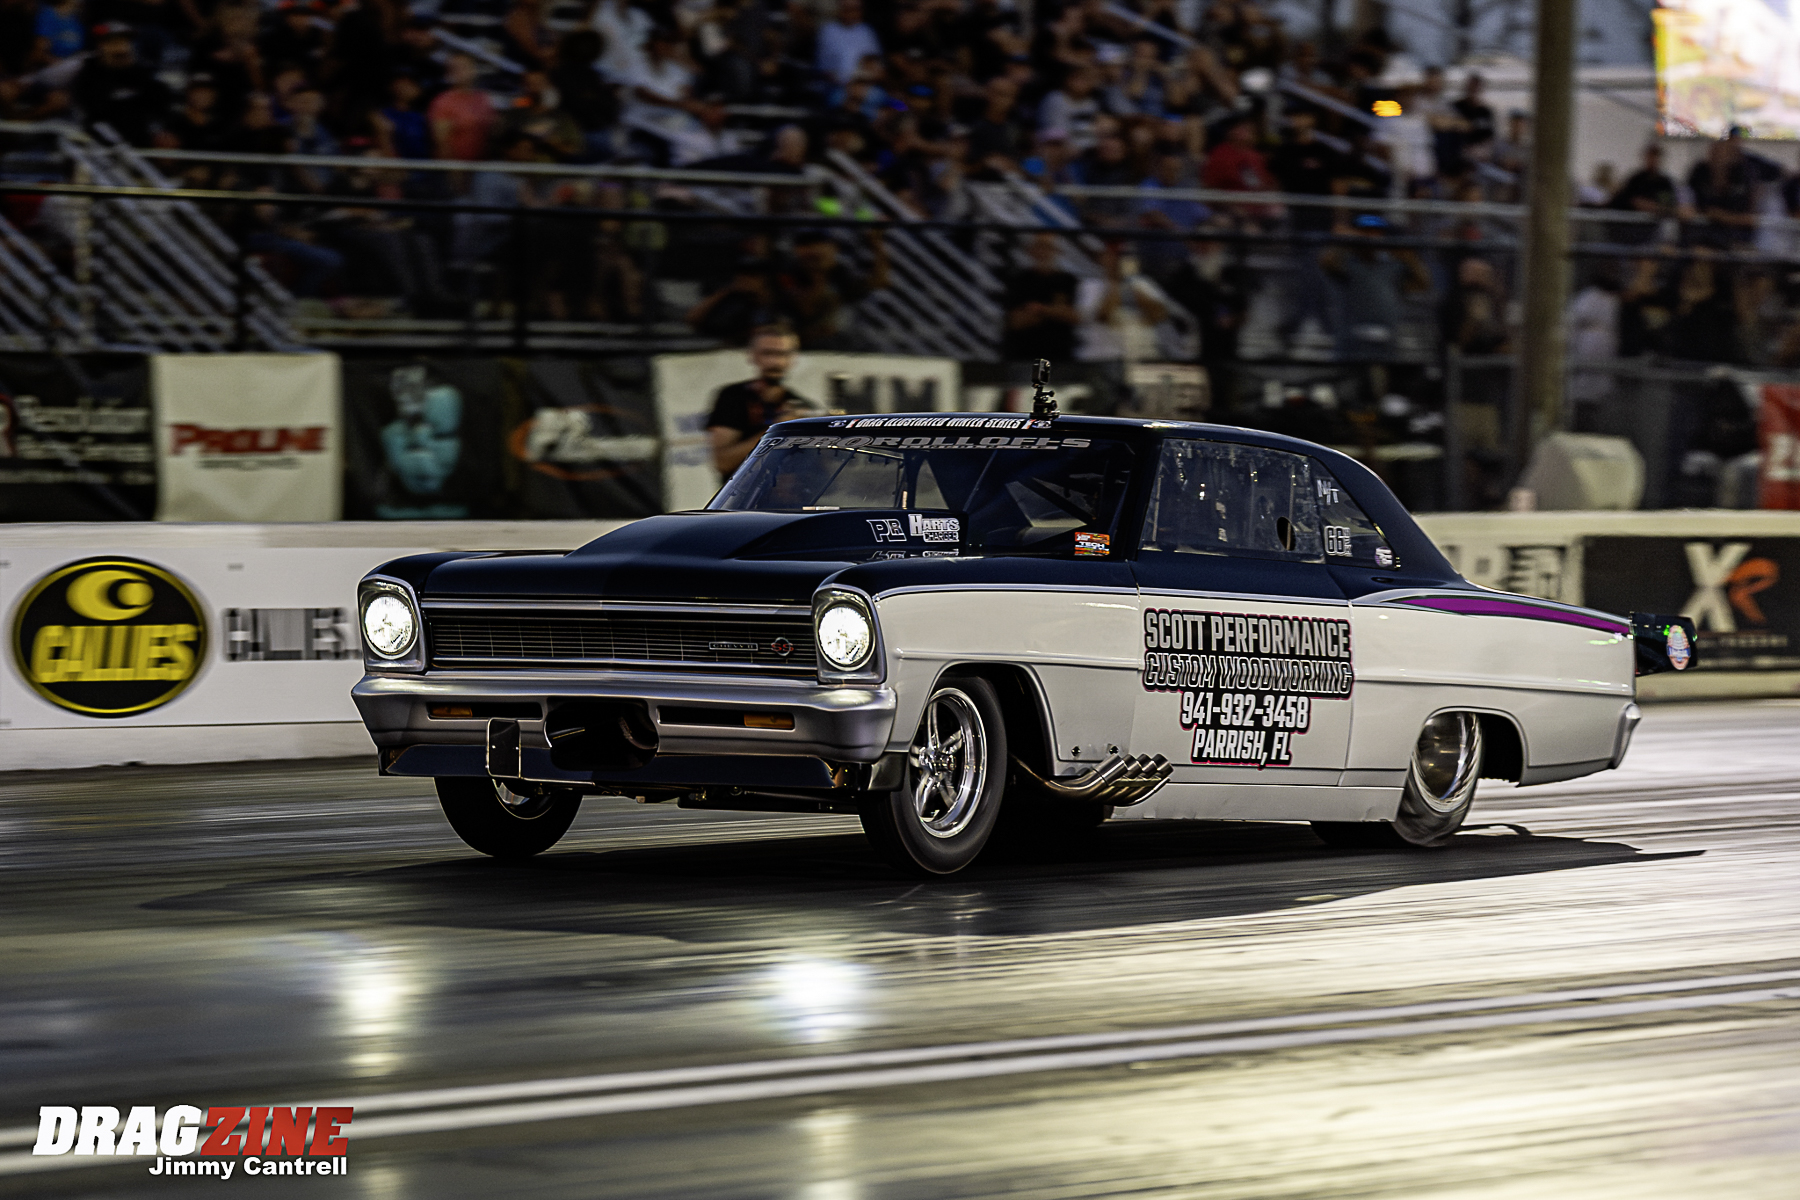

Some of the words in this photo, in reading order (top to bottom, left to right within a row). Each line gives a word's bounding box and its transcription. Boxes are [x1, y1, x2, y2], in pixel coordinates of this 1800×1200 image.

[855, 418, 888, 428] DRAG
[984, 418, 1024, 429] SERIES
[1146, 612, 1206, 650] SCOTT
[1210, 615, 1350, 658] PERFORMANCE
[1145, 652, 1217, 688] CUSTOM
[1219, 656, 1352, 694] WOODWORKING
[1181, 692, 1309, 728] 941-932-3458
[1193, 729, 1268, 765] PARRISH,
[1271, 732, 1290, 761] FL
